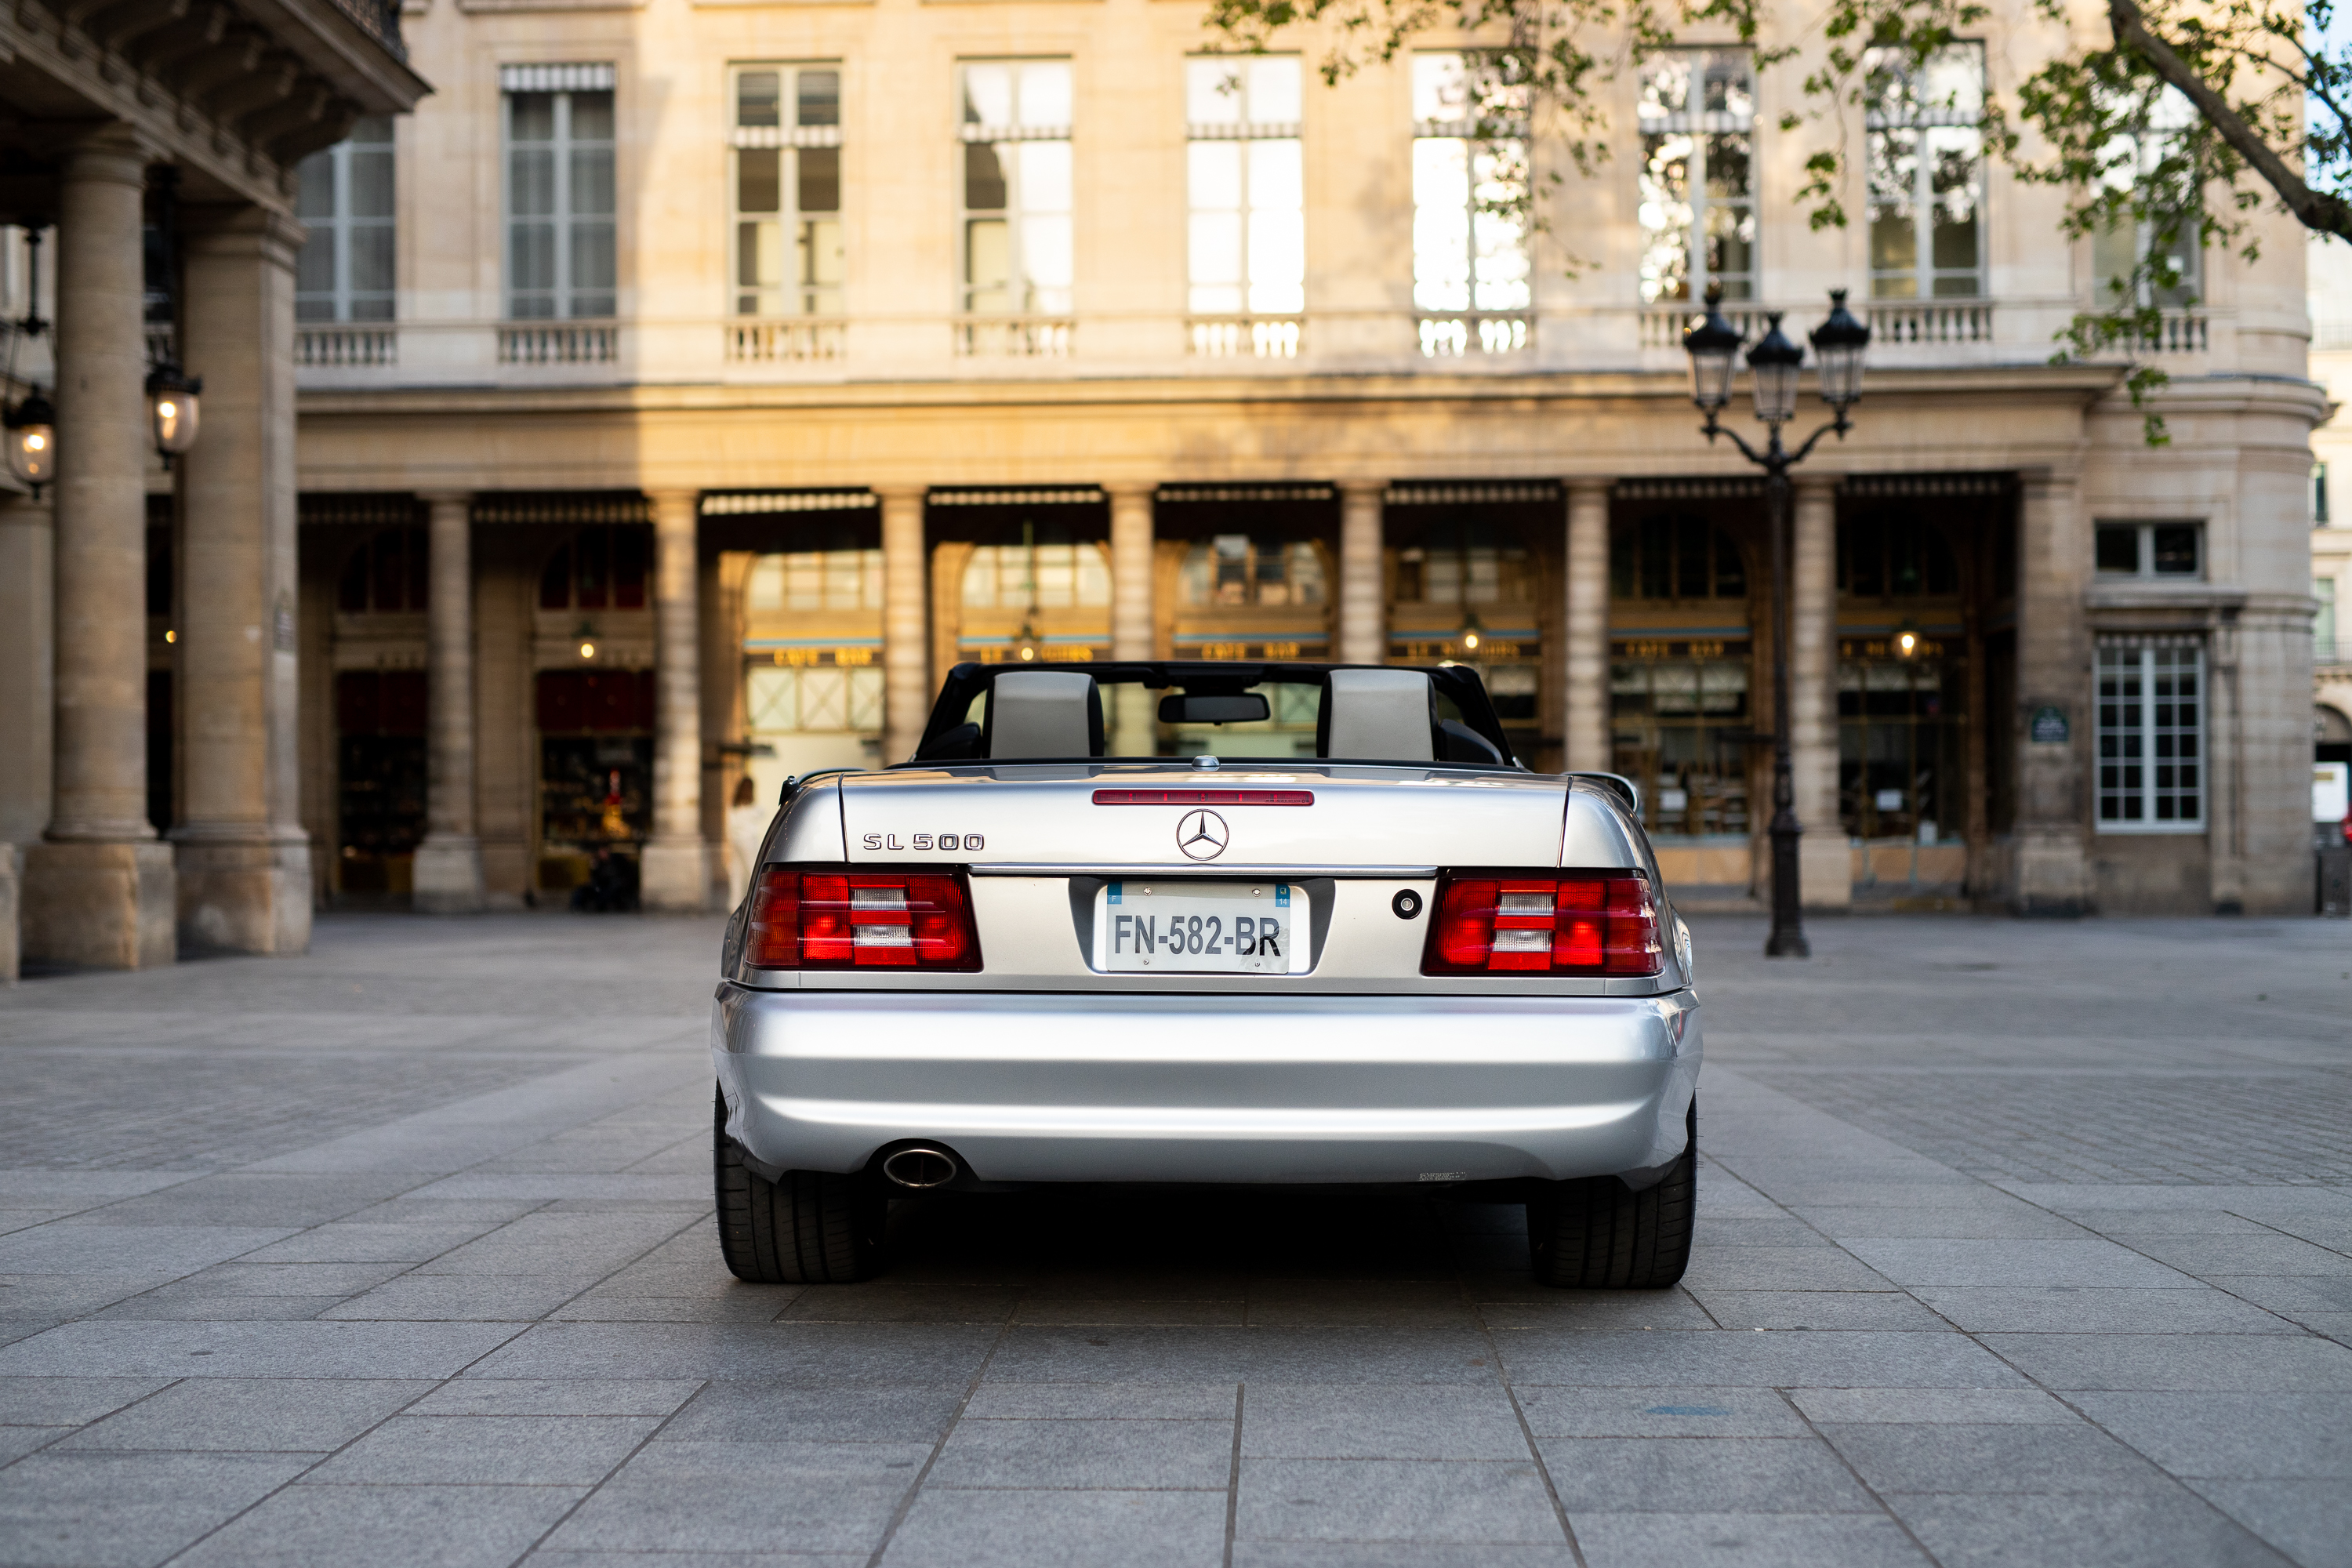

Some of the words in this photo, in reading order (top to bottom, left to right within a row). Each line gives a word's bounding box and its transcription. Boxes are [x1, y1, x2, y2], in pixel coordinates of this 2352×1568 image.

[863, 833, 905, 850] SL
[913, 833, 985, 851] 500
[1115, 915, 1281, 956] FN-582-BR
